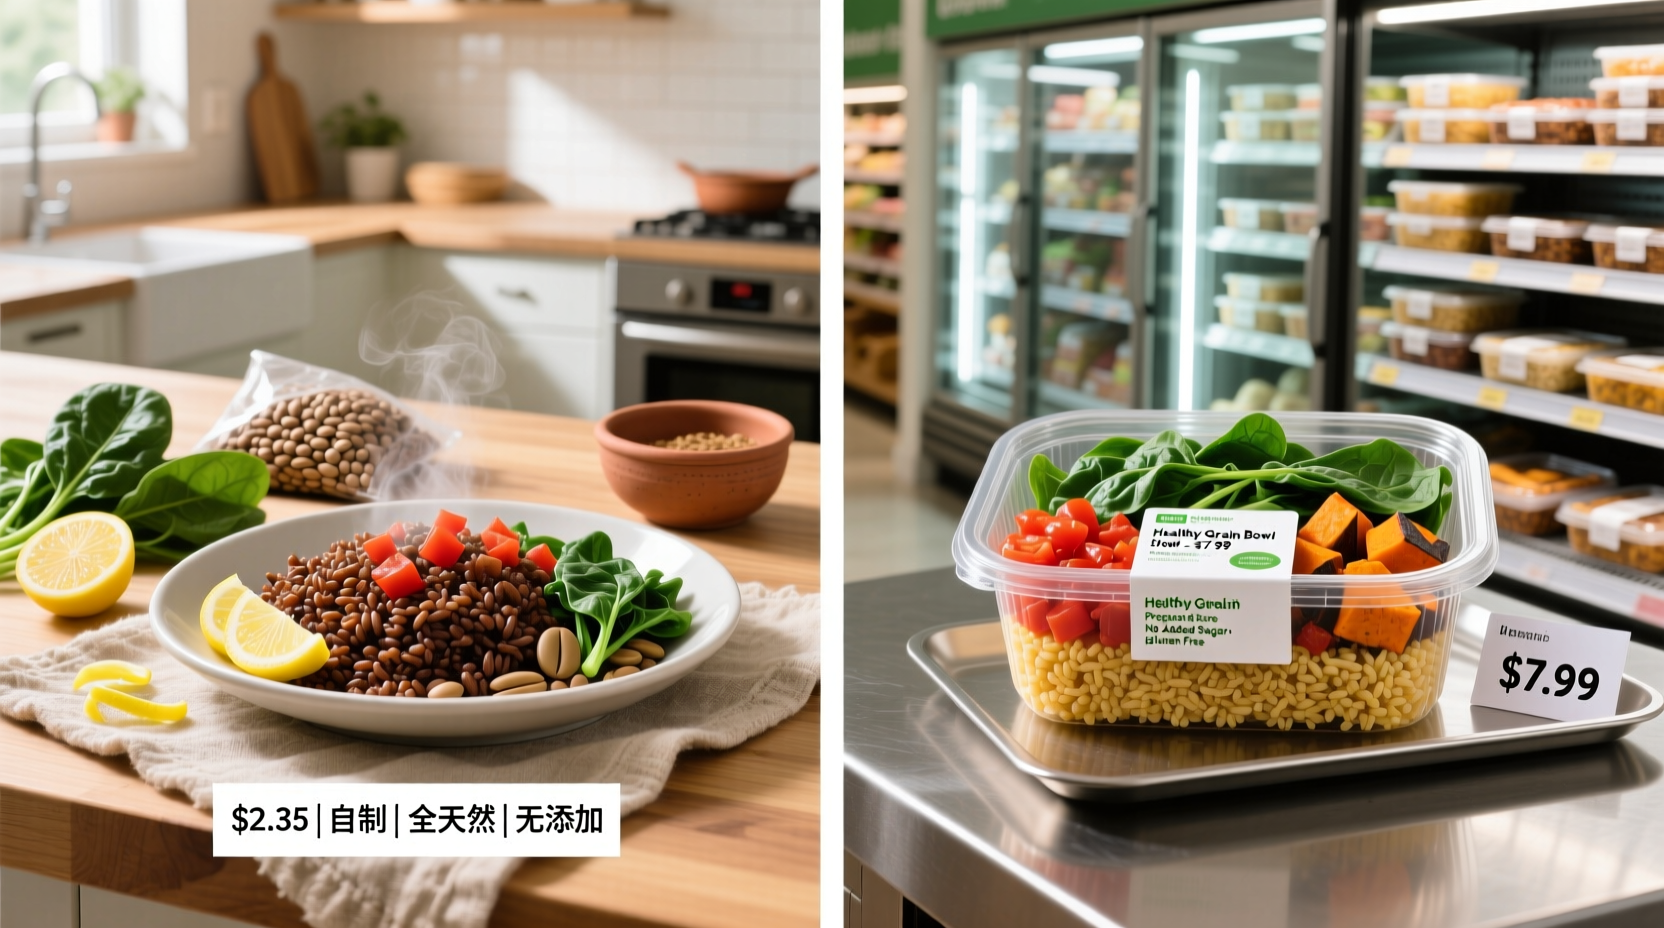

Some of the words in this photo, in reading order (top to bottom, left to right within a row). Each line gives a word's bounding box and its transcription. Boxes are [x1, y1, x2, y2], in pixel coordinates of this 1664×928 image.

[1244, 530, 1276, 540] Bowl
[1145, 623, 1159, 633] No
[1183, 636, 1205, 646] Free
[1499, 651, 1600, 701] $7.99
